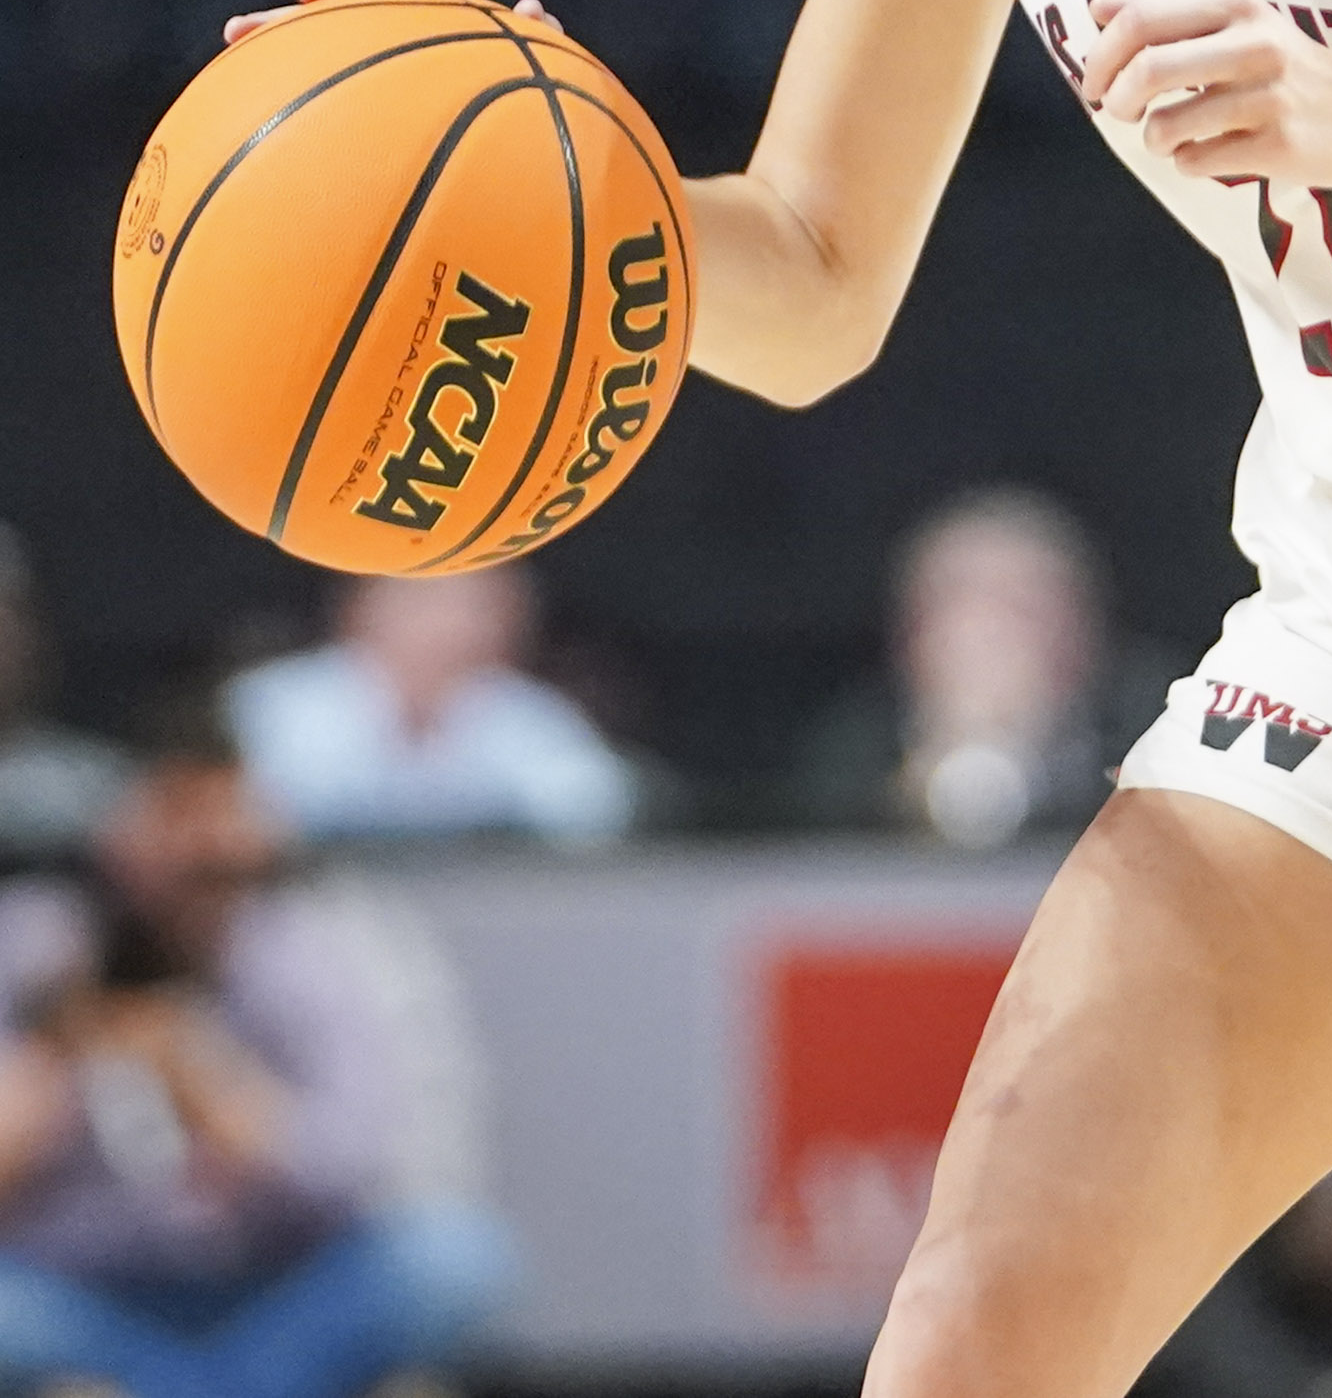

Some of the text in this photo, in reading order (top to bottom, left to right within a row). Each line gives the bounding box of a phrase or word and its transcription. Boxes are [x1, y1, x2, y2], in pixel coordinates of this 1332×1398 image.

[328, 260, 447, 505] OFFICIAL GAME BALL
[351, 269, 532, 532] NCAA
